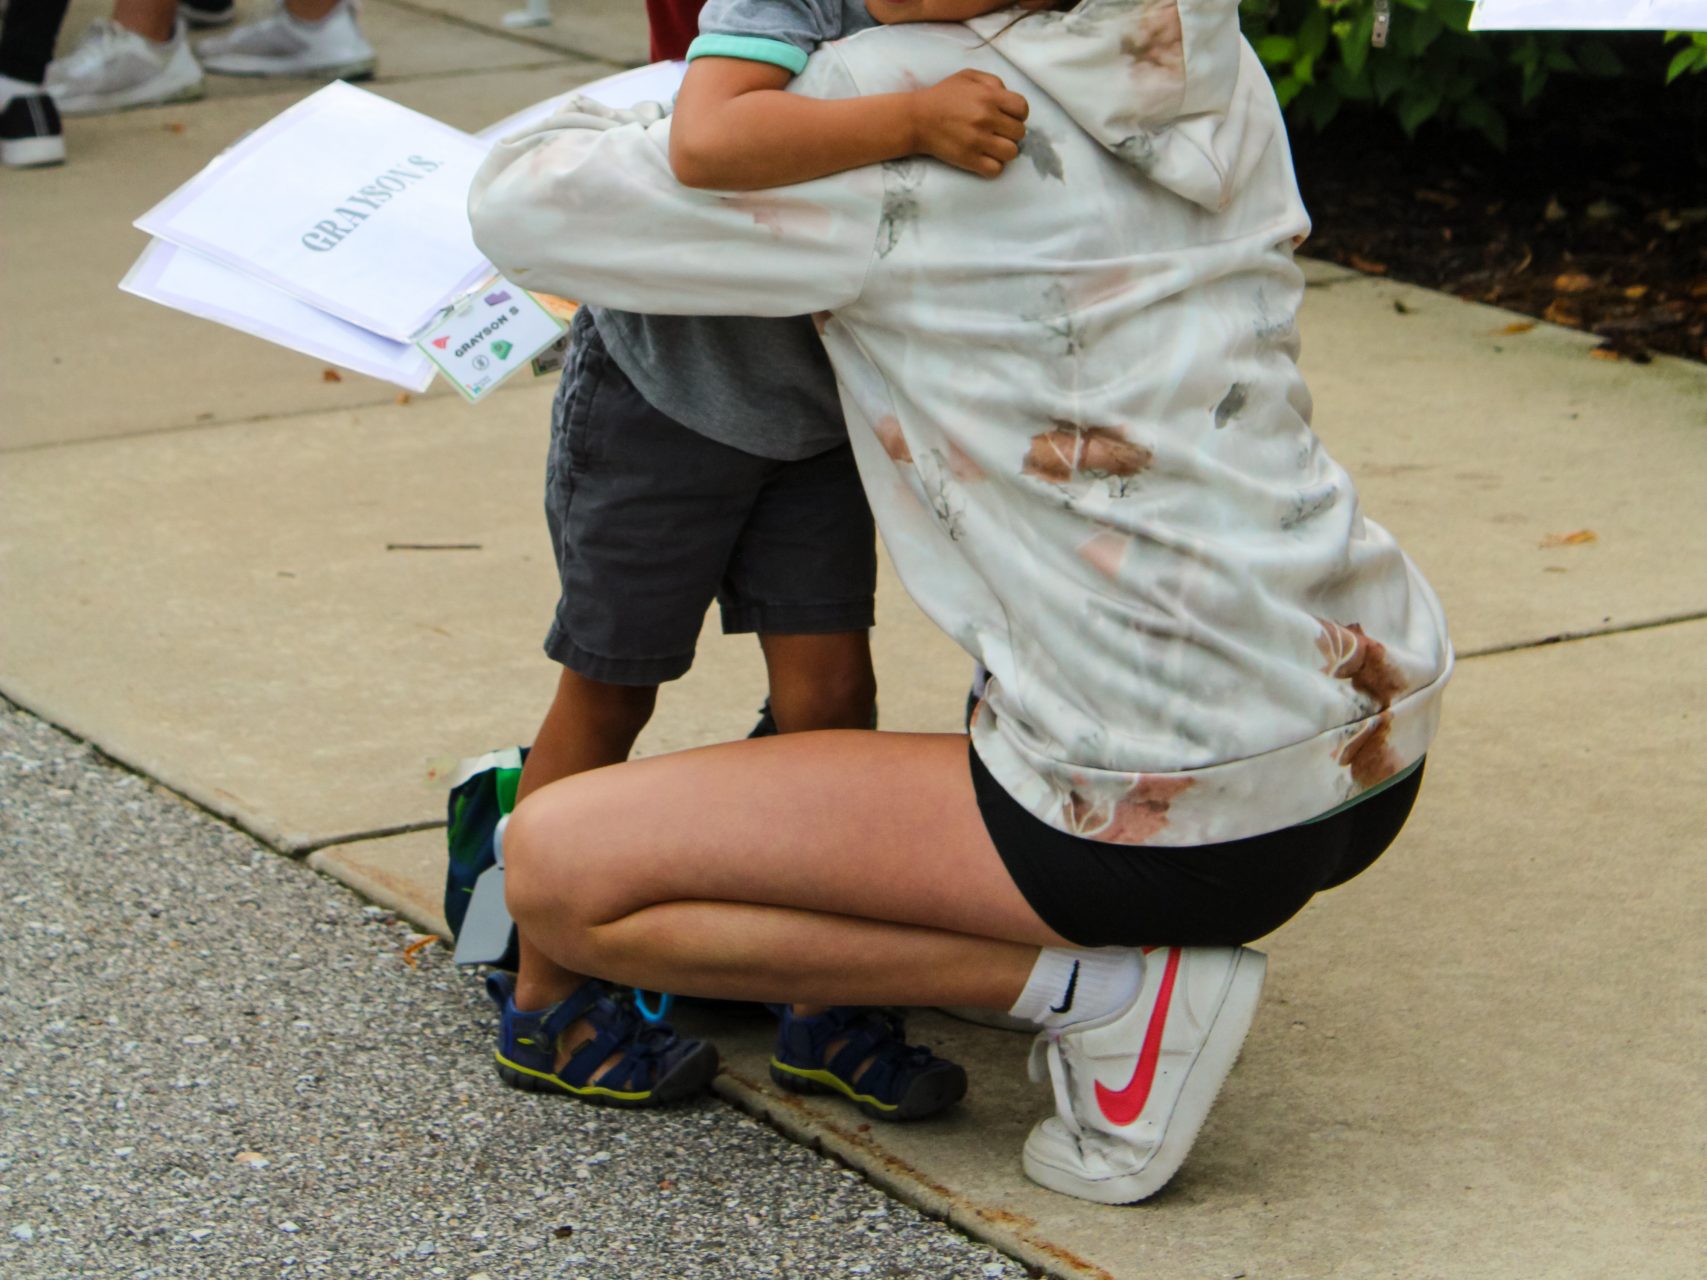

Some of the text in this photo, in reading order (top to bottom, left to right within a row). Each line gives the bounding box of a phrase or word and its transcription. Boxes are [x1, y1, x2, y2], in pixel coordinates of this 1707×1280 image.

[301, 162, 424, 253] GRAYSON
[454, 306, 520, 358] GRAYSON S
